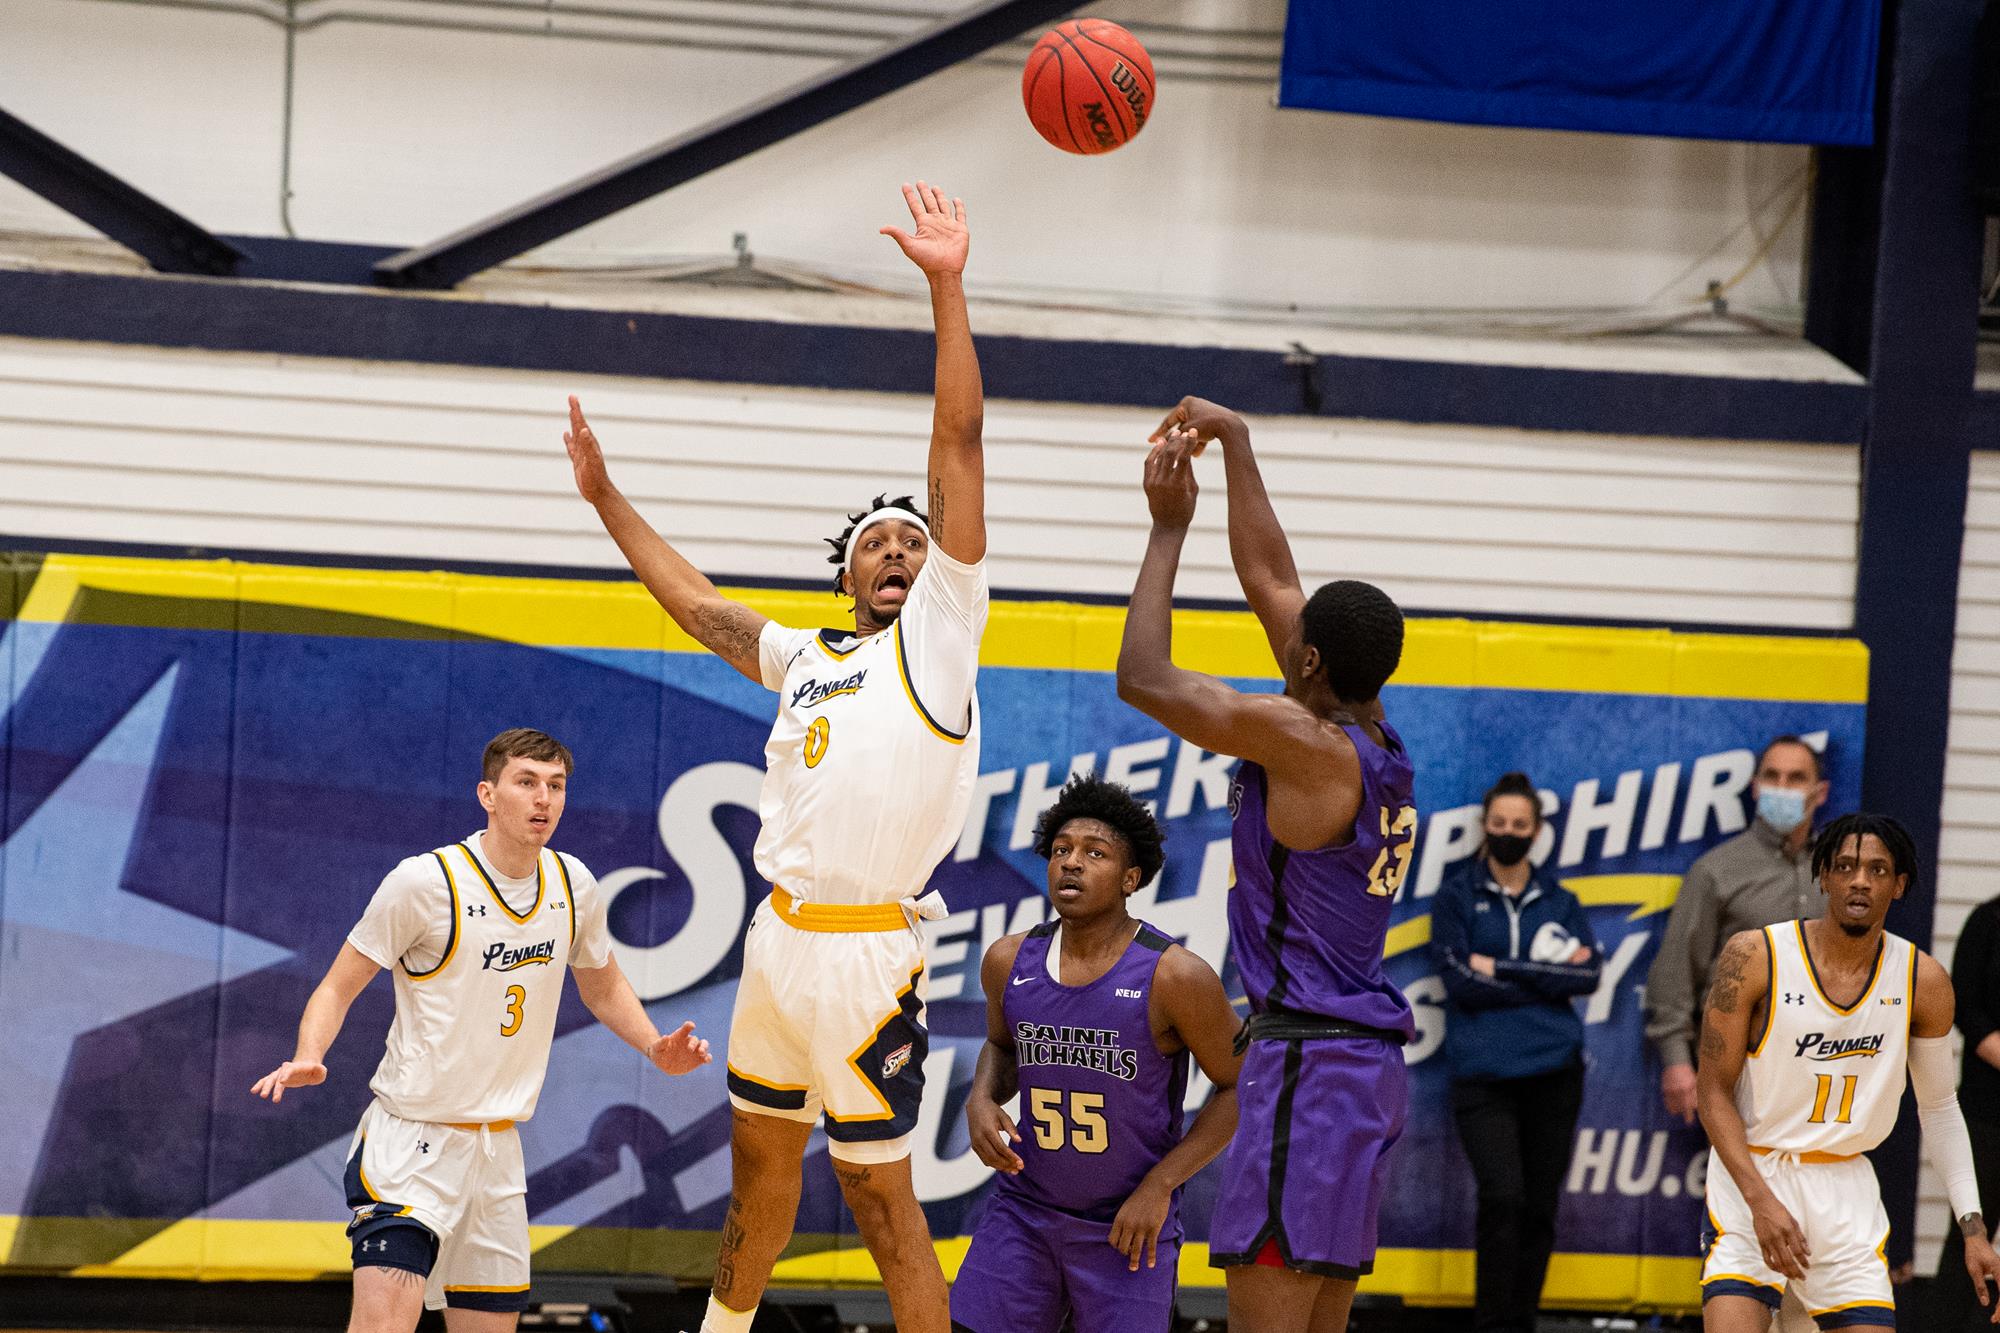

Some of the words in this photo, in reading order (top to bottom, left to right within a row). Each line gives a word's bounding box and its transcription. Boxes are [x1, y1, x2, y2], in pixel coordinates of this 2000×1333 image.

[803, 715, 831, 770] 0
[482, 938, 556, 971] PENMEN
[925, 896, 1056, 1001] EW
[501, 984, 527, 1038] 3
[1017, 1021, 1119, 1048] SAINT
[1794, 1032, 1885, 1059] PENMEN
[1029, 1086, 1110, 1154] 55
[1807, 1073, 1859, 1124] 11
